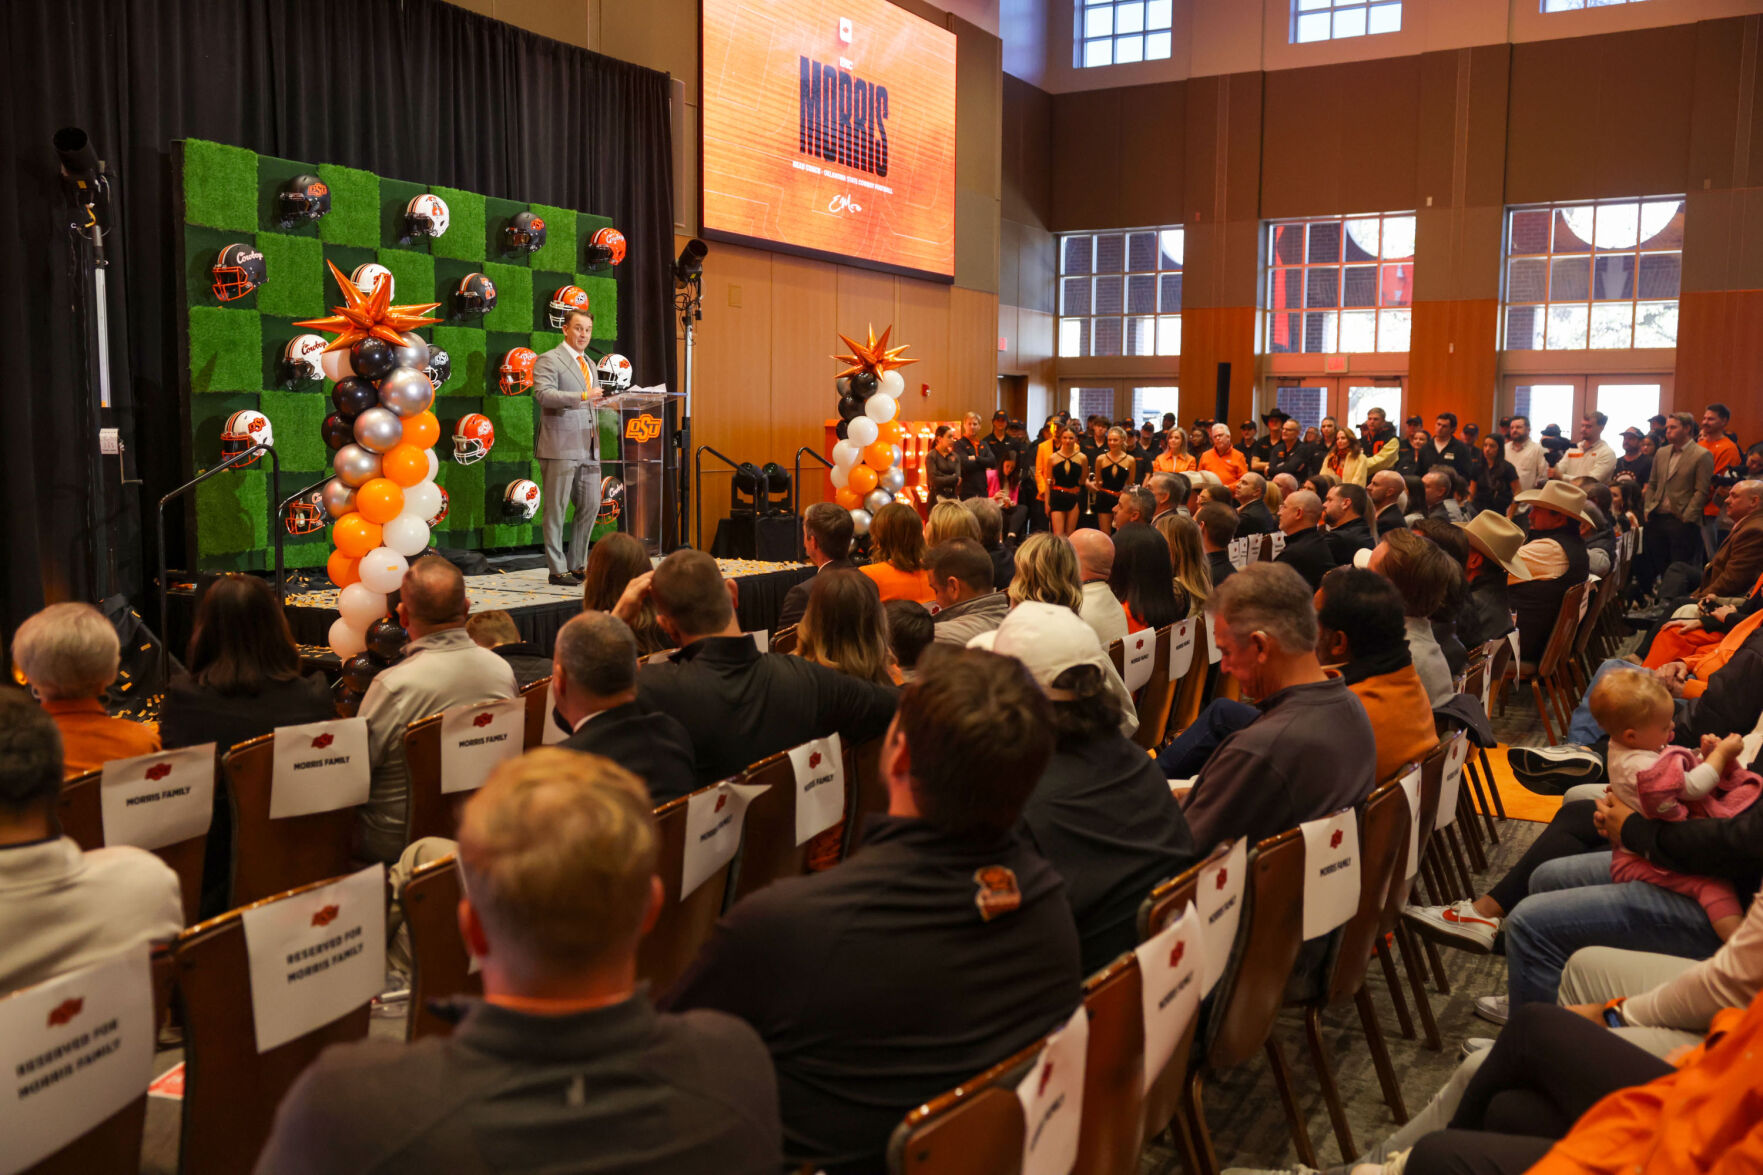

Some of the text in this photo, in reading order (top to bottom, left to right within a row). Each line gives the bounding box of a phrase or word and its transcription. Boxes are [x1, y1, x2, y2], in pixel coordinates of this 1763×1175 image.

[800, 55, 889, 178] MORRIS
[625, 413, 662, 443] OSU
[459, 733, 507, 748] MORRIS FAMILY
[294, 756, 350, 770] MORRIS FAMILY
[126, 786, 191, 807] MORRIS FAMILY
[287, 926, 362, 965] RESERVED FOR
[287, 943, 363, 984] MORRIS FAMILY
[16, 1033, 90, 1077] RESERVED
[18, 1064, 73, 1100] MORRIS
